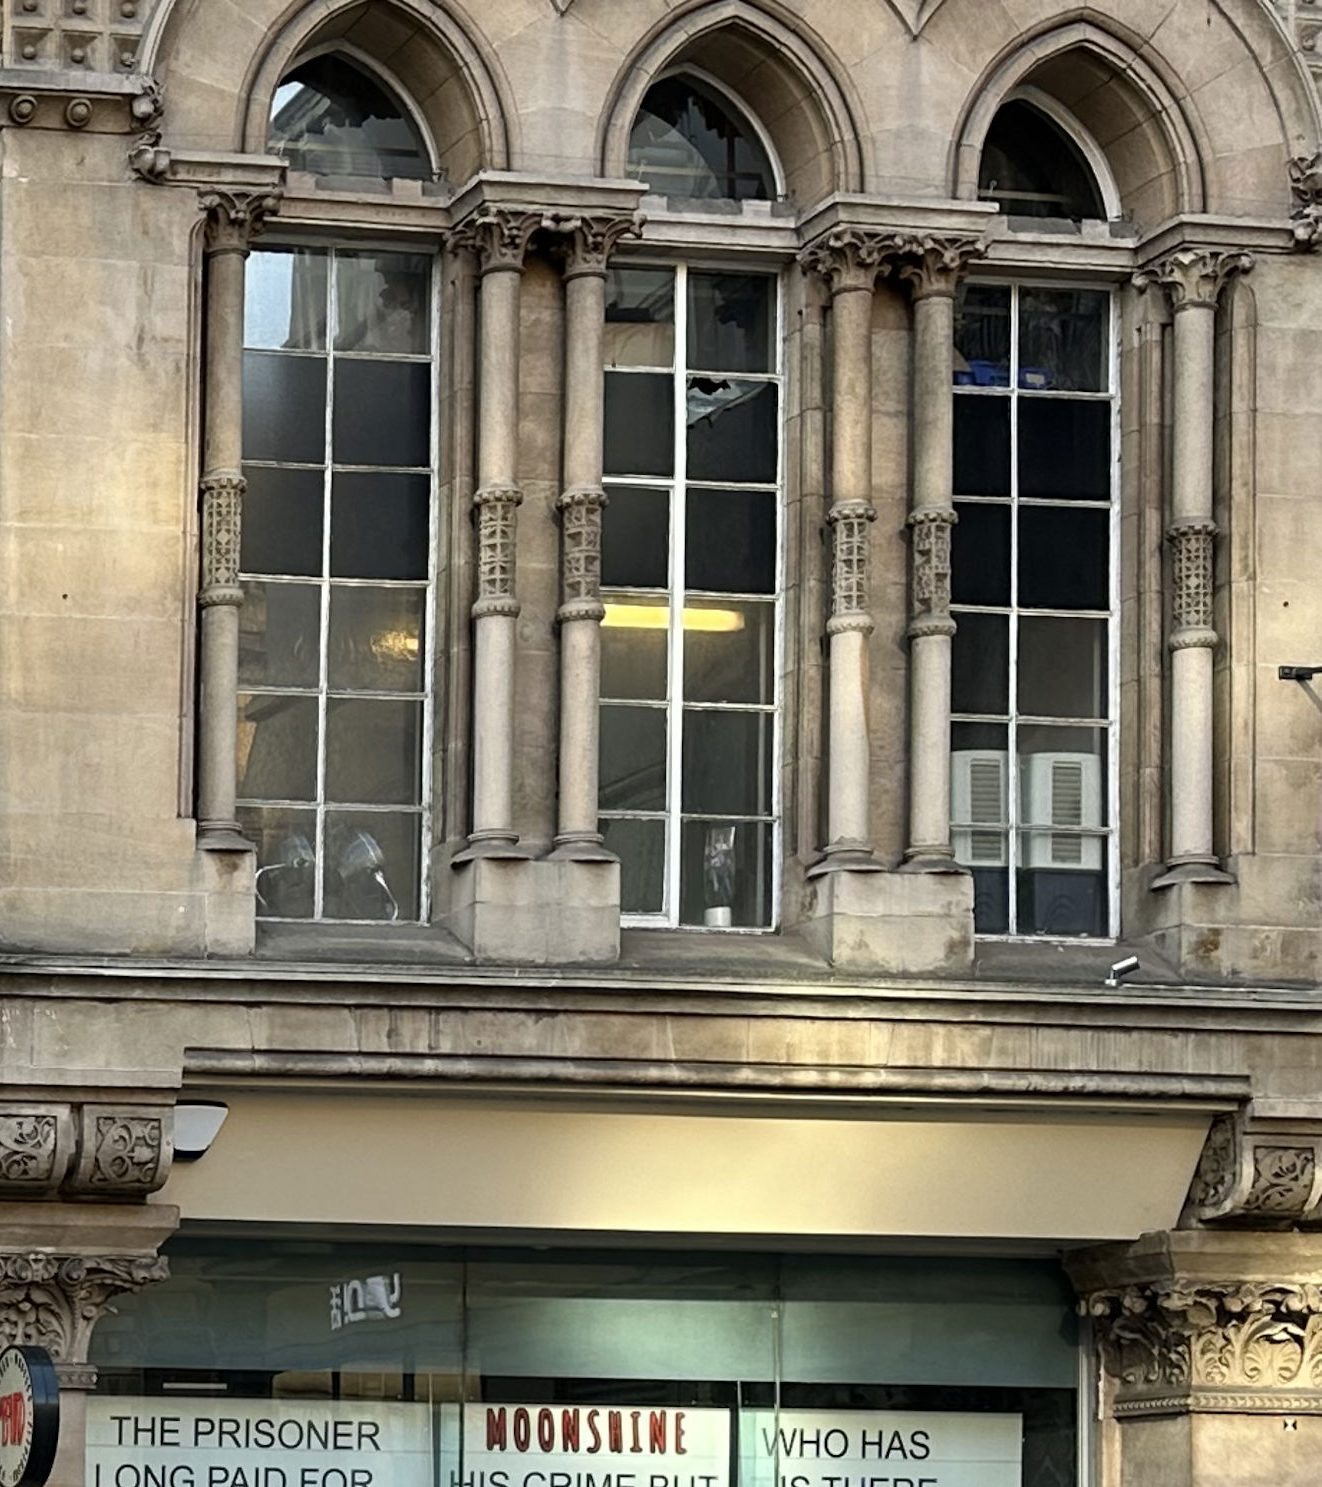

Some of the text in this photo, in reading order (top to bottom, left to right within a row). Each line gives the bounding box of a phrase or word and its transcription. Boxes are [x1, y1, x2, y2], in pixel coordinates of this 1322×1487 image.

[110, 1416, 381, 1451] THE PRISONER
[486, 1407, 688, 1455] MOONSHINE
[762, 1428, 930, 1460] WHO HAS
